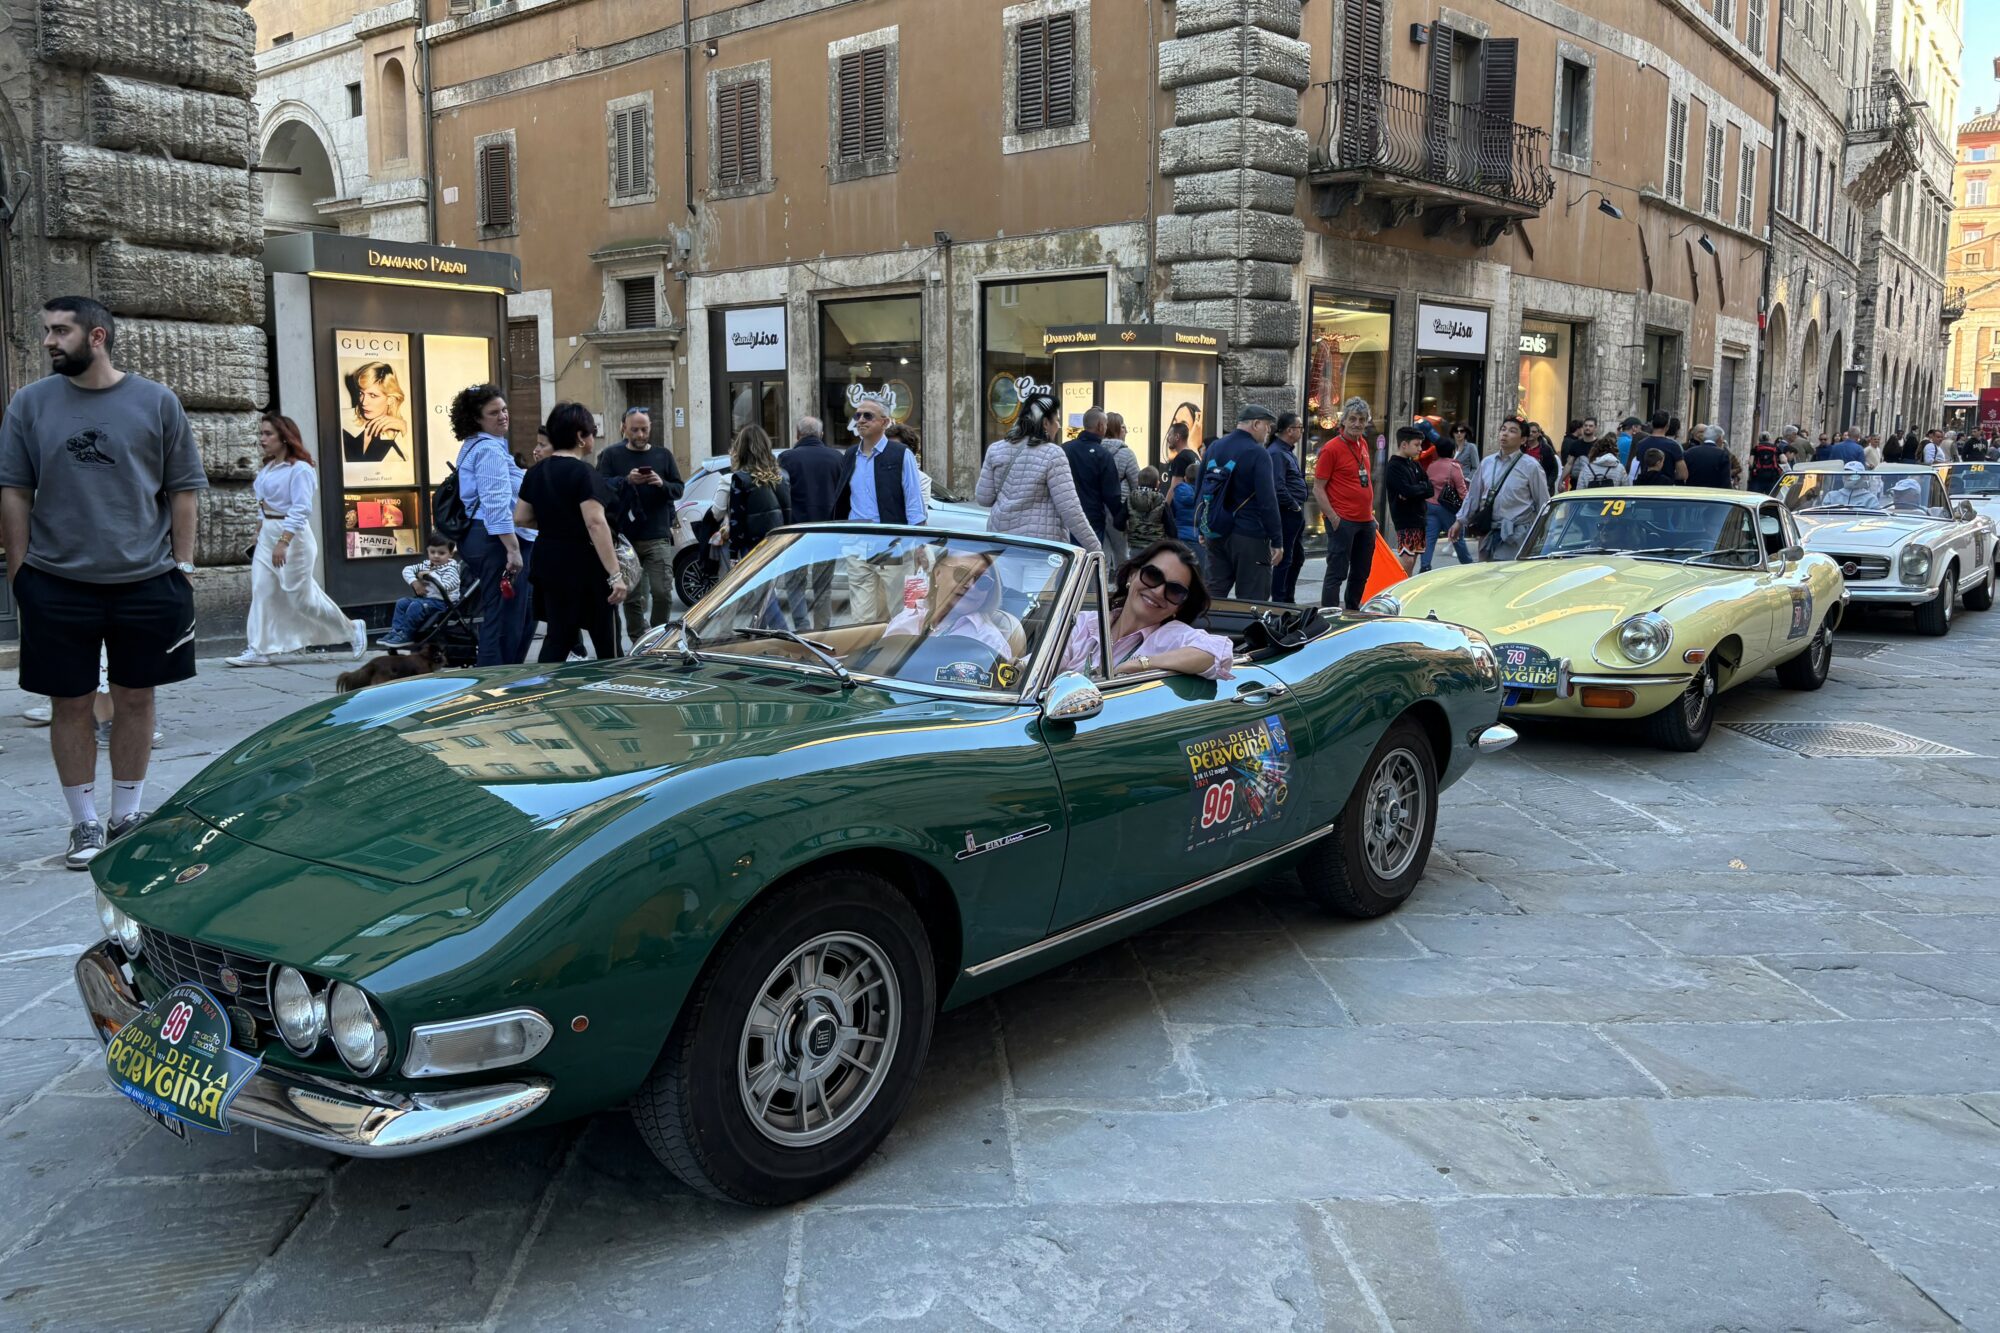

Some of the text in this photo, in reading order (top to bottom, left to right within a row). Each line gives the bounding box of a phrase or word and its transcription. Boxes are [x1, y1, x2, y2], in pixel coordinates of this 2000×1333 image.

[368, 249, 467, 274] DAMIANO PARATI
[341, 337, 401, 352] GUCCI
[1519, 334, 1547, 353] ZENIS
[1065, 387, 1092, 396] GUCC
[1600, 500, 1626, 516] 79
[1507, 650, 1526, 664] 79
[1186, 739, 1225, 756] COPPA
[1229, 727, 1265, 743] DELLA
[1201, 779, 1235, 829] 96
[160, 1001, 193, 1045] 96
[816, 1029, 830, 1049] FIAT
[120, 1024, 157, 1057] COPPA
[165, 1048, 229, 1089] DELLA
